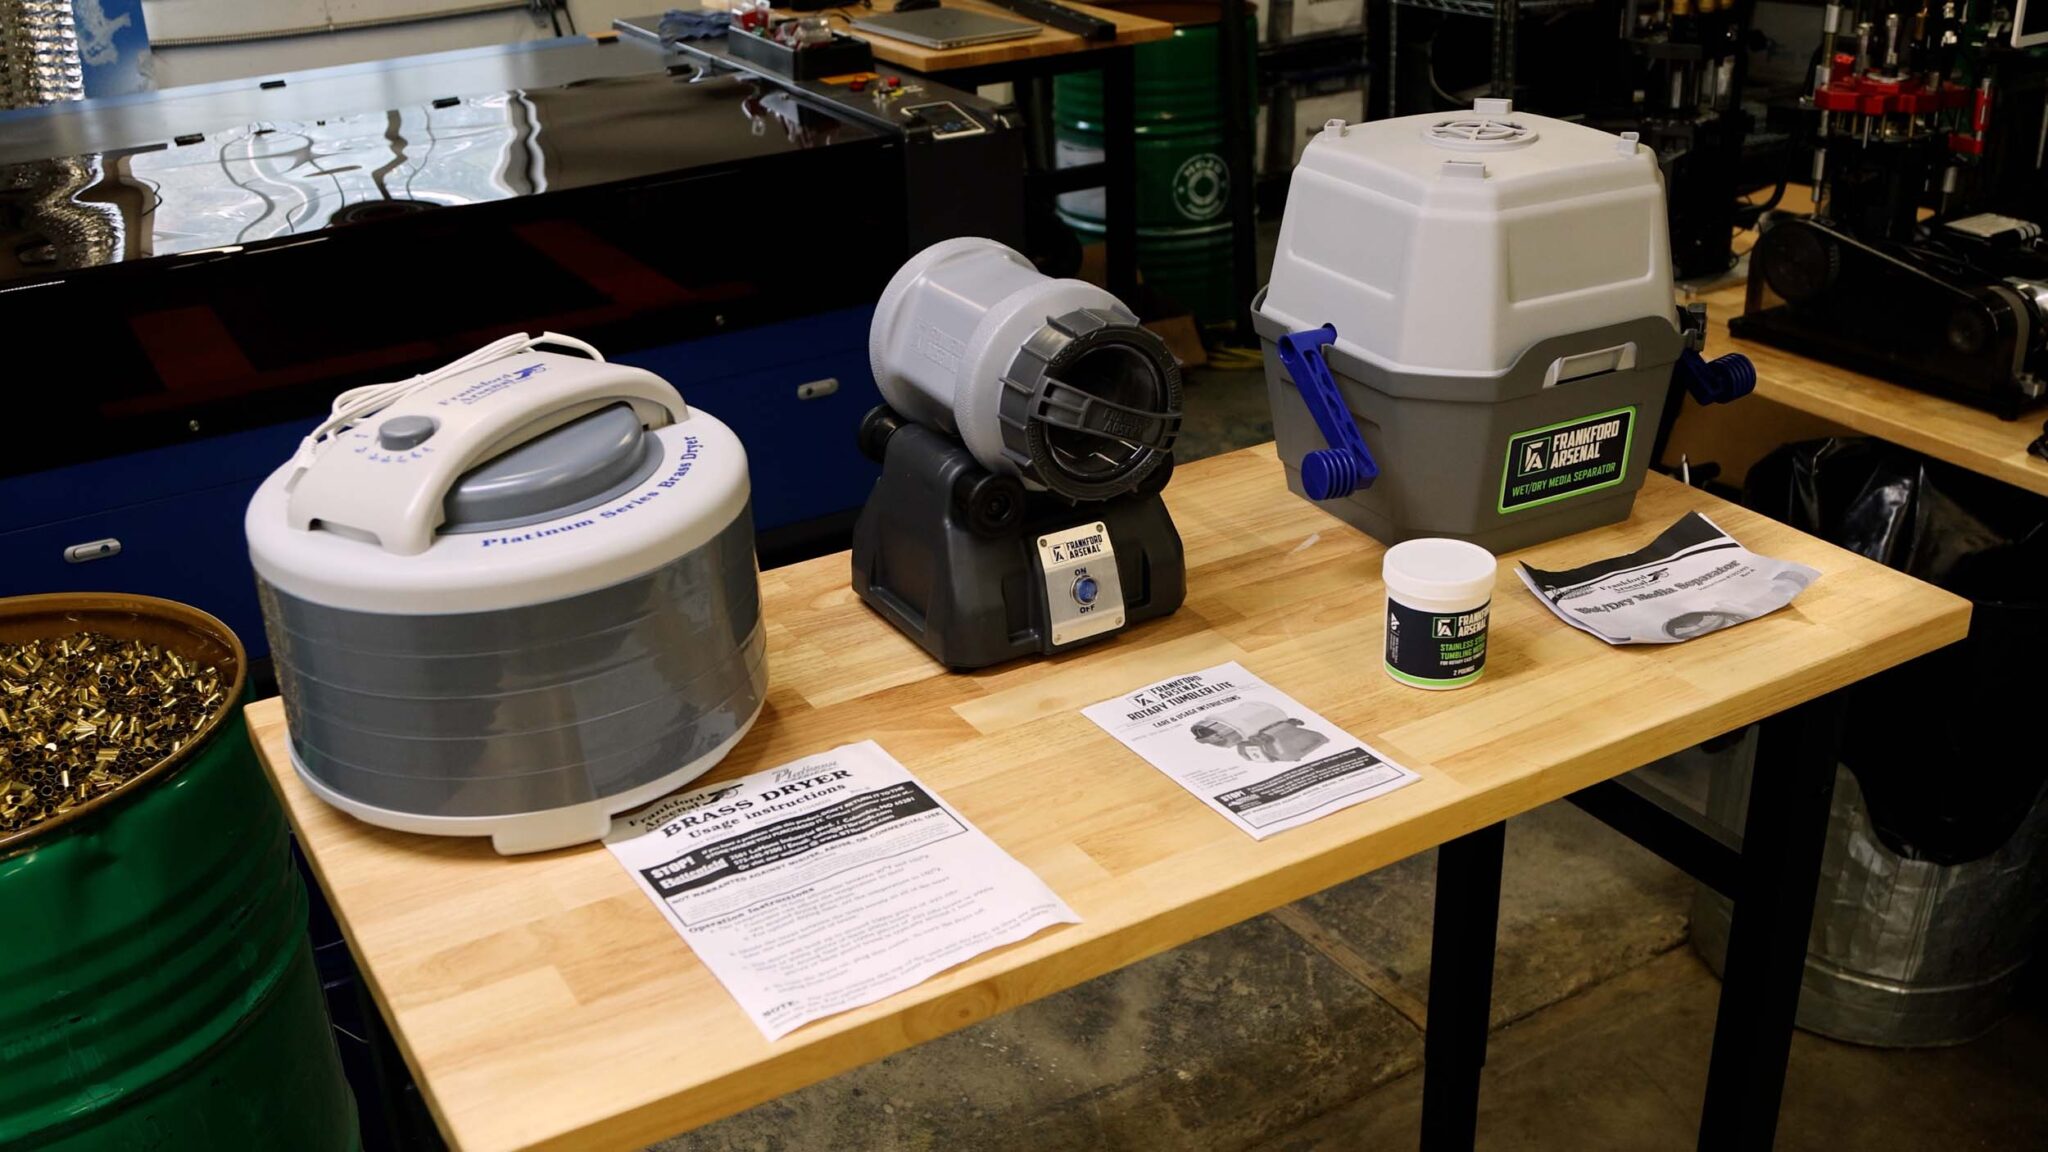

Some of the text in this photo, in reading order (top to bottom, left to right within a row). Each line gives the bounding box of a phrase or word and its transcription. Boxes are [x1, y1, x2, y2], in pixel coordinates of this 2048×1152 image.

[1552, 420, 1620, 452] FRANKFORD
[1550, 442, 1601, 470] ARSENAL
[481, 436, 704, 547] Platinum Series Brass Dryer
[1512, 462, 1616, 498] WET/DRY MEDIA SEPARATOR
[1066, 534, 1103, 551] FRANKFORD
[1069, 544, 1101, 559] ARSENAL
[1074, 567, 1087, 576] ON
[1599, 574, 1647, 591] Frankford
[1674, 560, 1741, 590] Separator
[1440, 639, 1474, 652] STAINLESS
[1440, 649, 1473, 660] TUMBLING
[1150, 675, 1202, 695] FRANKFORD
[1159, 682, 1205, 700] ARSENAL
[1127, 702, 1169, 721] ROTARY
[1167, 687, 1213, 706] TUMBLER
[1211, 681, 1236, 692] LITE
[1195, 695, 1242, 713] INSTRUCTIONS
[629, 793, 706, 828] Frankford
[646, 802, 701, 829] Arsenal
[661, 799, 754, 839] BRASS
[759, 768, 853, 802] DRYER
[688, 817, 742, 840] Usage
[744, 782, 847, 821] instructions
[649, 855, 696, 879] STOP!
